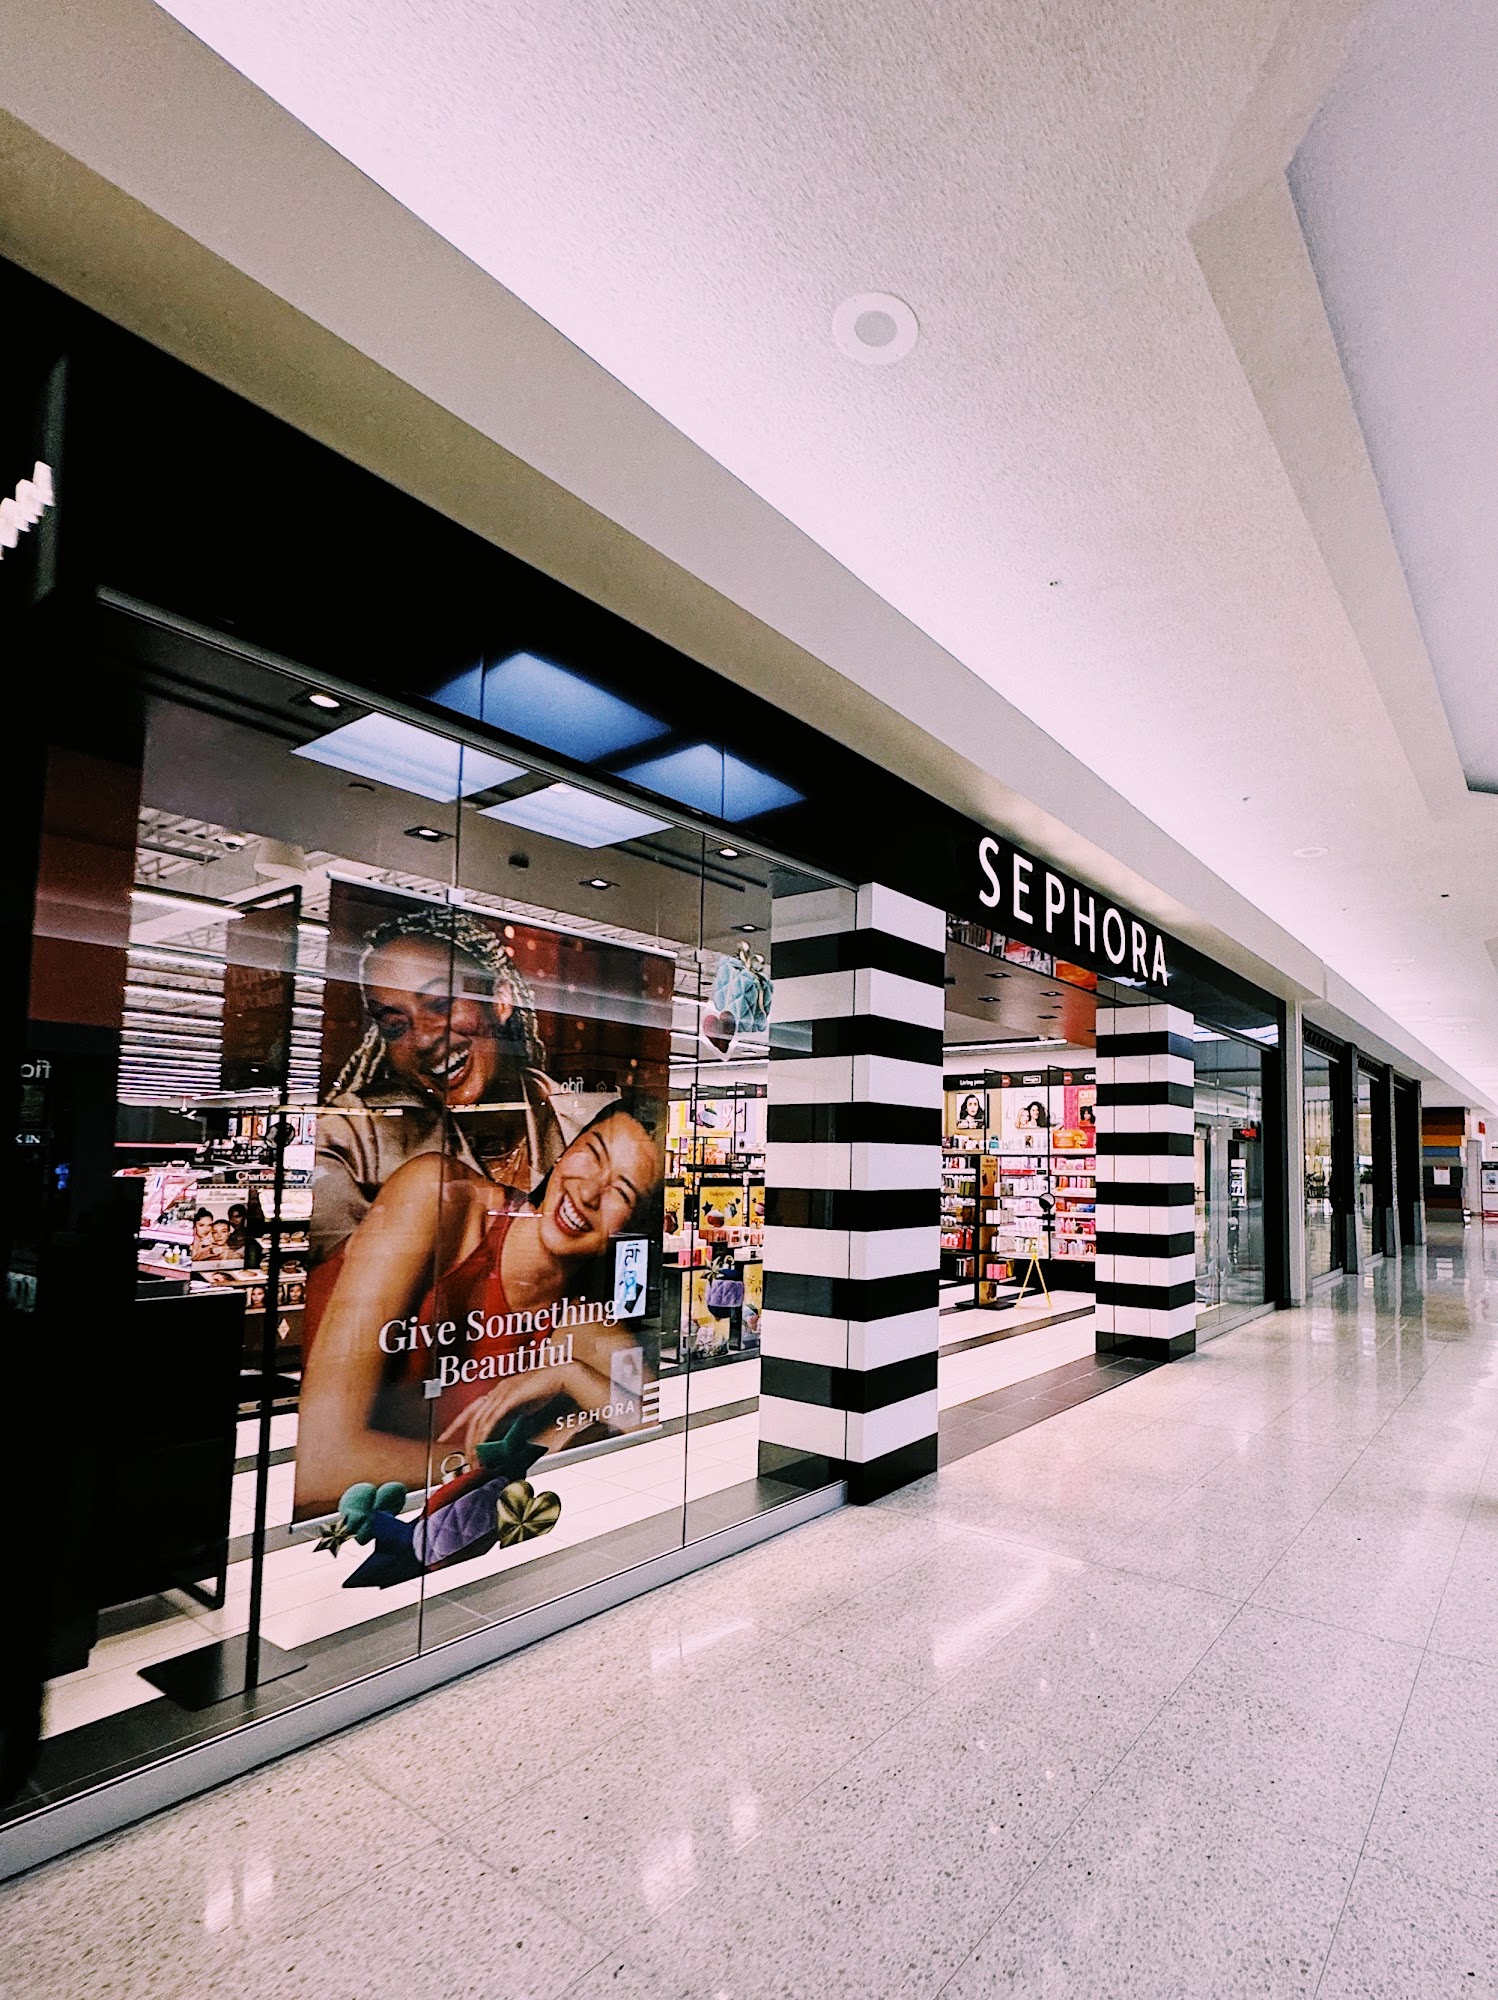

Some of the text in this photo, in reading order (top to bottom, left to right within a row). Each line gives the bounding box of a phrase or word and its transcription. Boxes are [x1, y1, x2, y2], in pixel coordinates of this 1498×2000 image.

[978, 836, 1168, 987] SEPHORA
[378, 1295, 620, 1354] Give Something
[438, 1334, 574, 1388] Beautiful
[555, 1400, 635, 1431] SEPHORA
